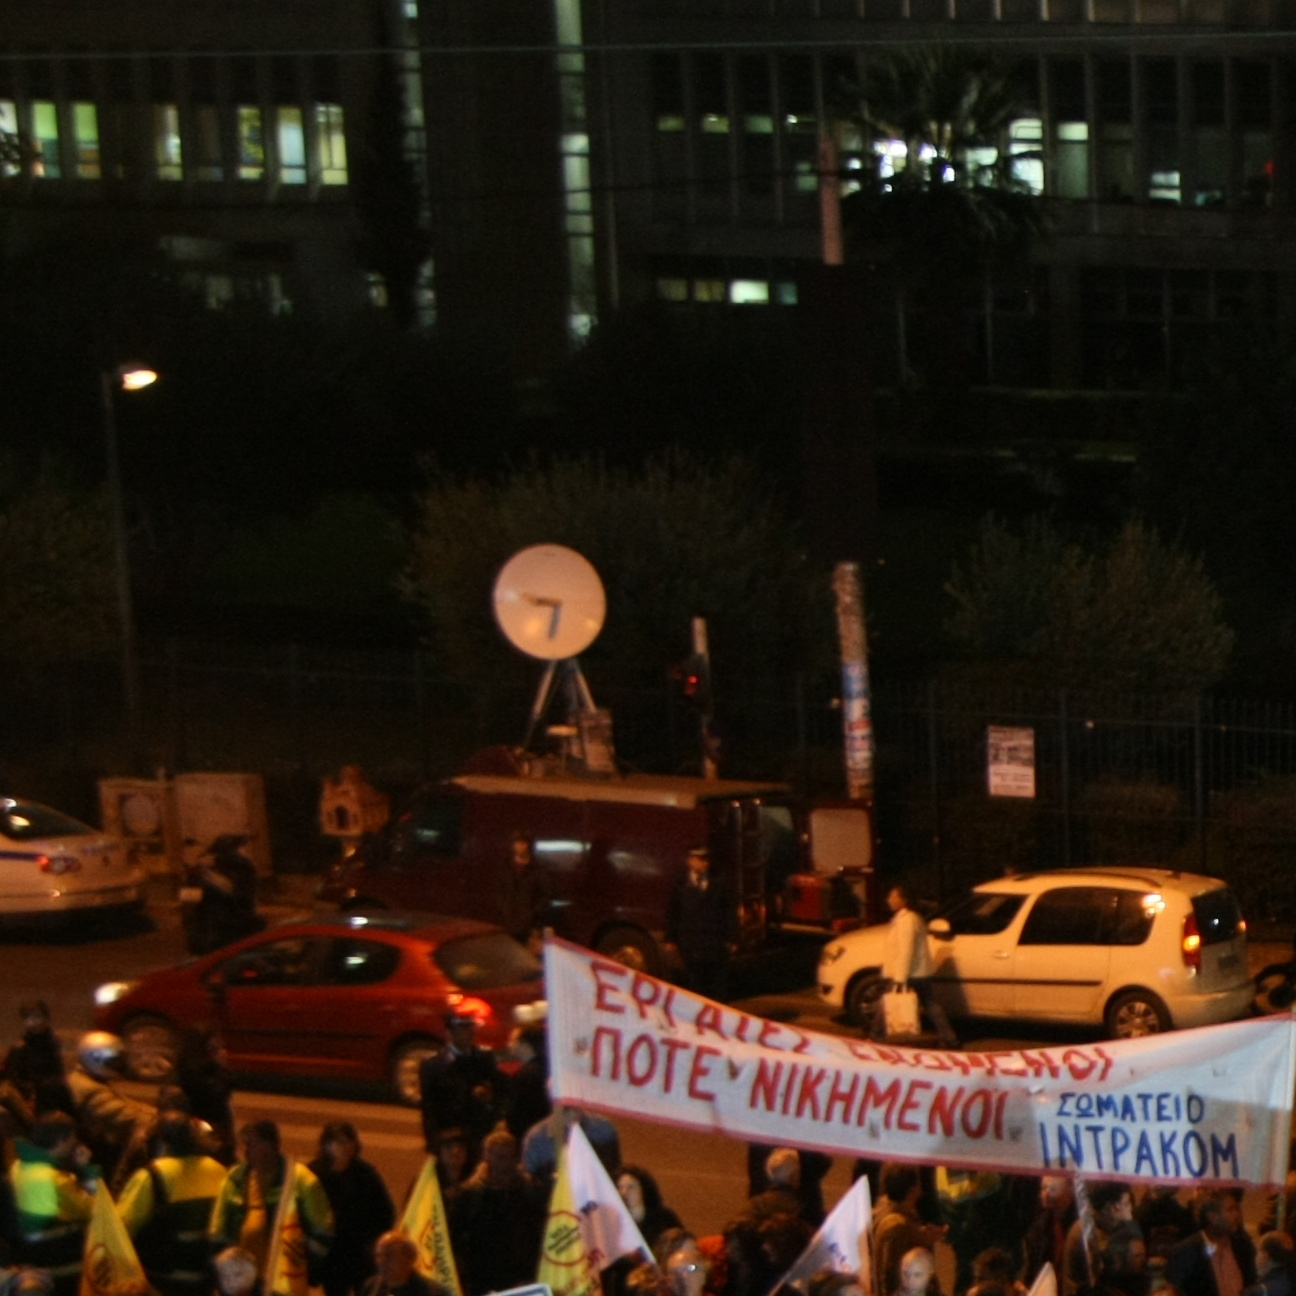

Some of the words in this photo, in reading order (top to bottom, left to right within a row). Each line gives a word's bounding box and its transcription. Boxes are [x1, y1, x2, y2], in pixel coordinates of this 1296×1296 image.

[590, 1025, 723, 1103] ΠΟΤΕ
[749, 1056, 1010, 1141] ΝΙΚΗΜΕΝΟΙ
[1056, 1091, 1206, 1125] ΣΩΜΑΤΕΙΟ
[1039, 1121, 1240, 1180] ΙΝΤΡΑΚΟΜ
